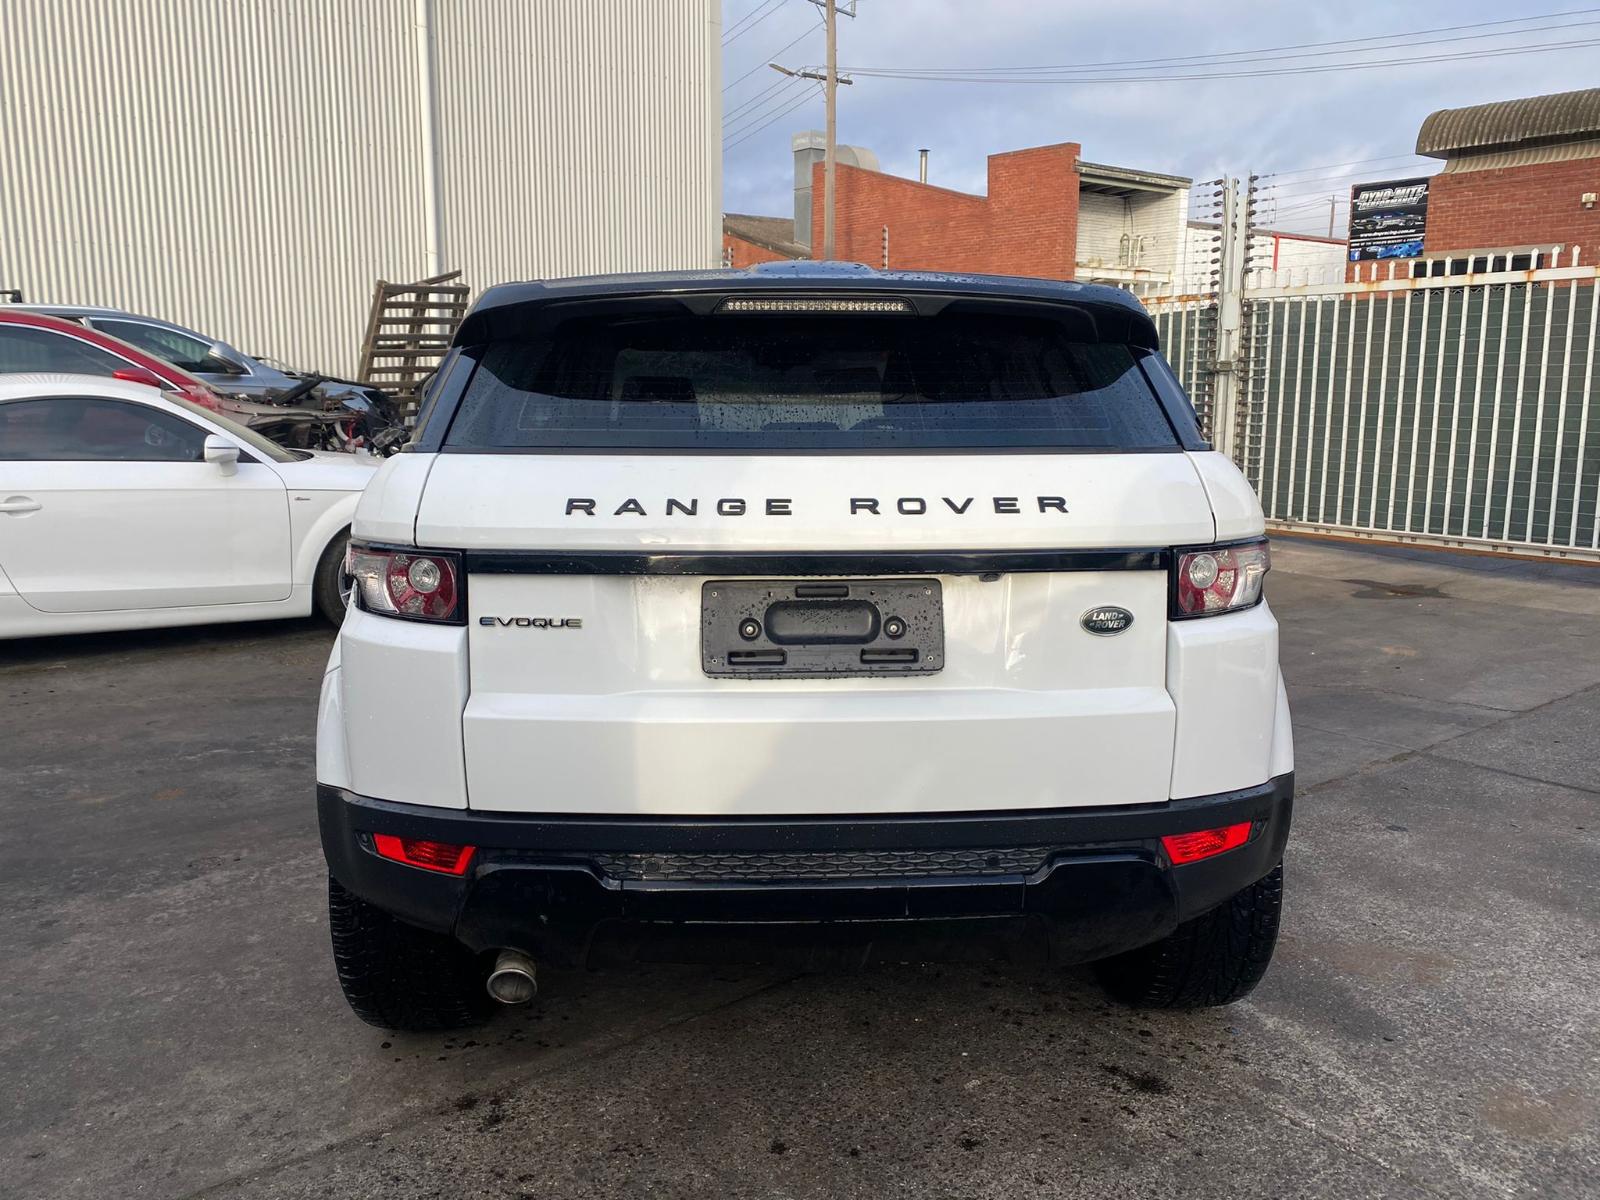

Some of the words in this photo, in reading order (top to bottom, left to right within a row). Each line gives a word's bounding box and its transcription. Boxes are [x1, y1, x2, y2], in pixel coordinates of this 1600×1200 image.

[1359, 186, 1426, 202] DYNO-MITE
[1361, 196, 1418, 208] PERFORMANCE
[565, 497, 793, 516] RANGE
[850, 496, 1069, 515] ROVER
[1092, 612, 1118, 620] LAND
[479, 616, 582, 629] EVOQUE
[1095, 620, 1126, 628] ROVER
